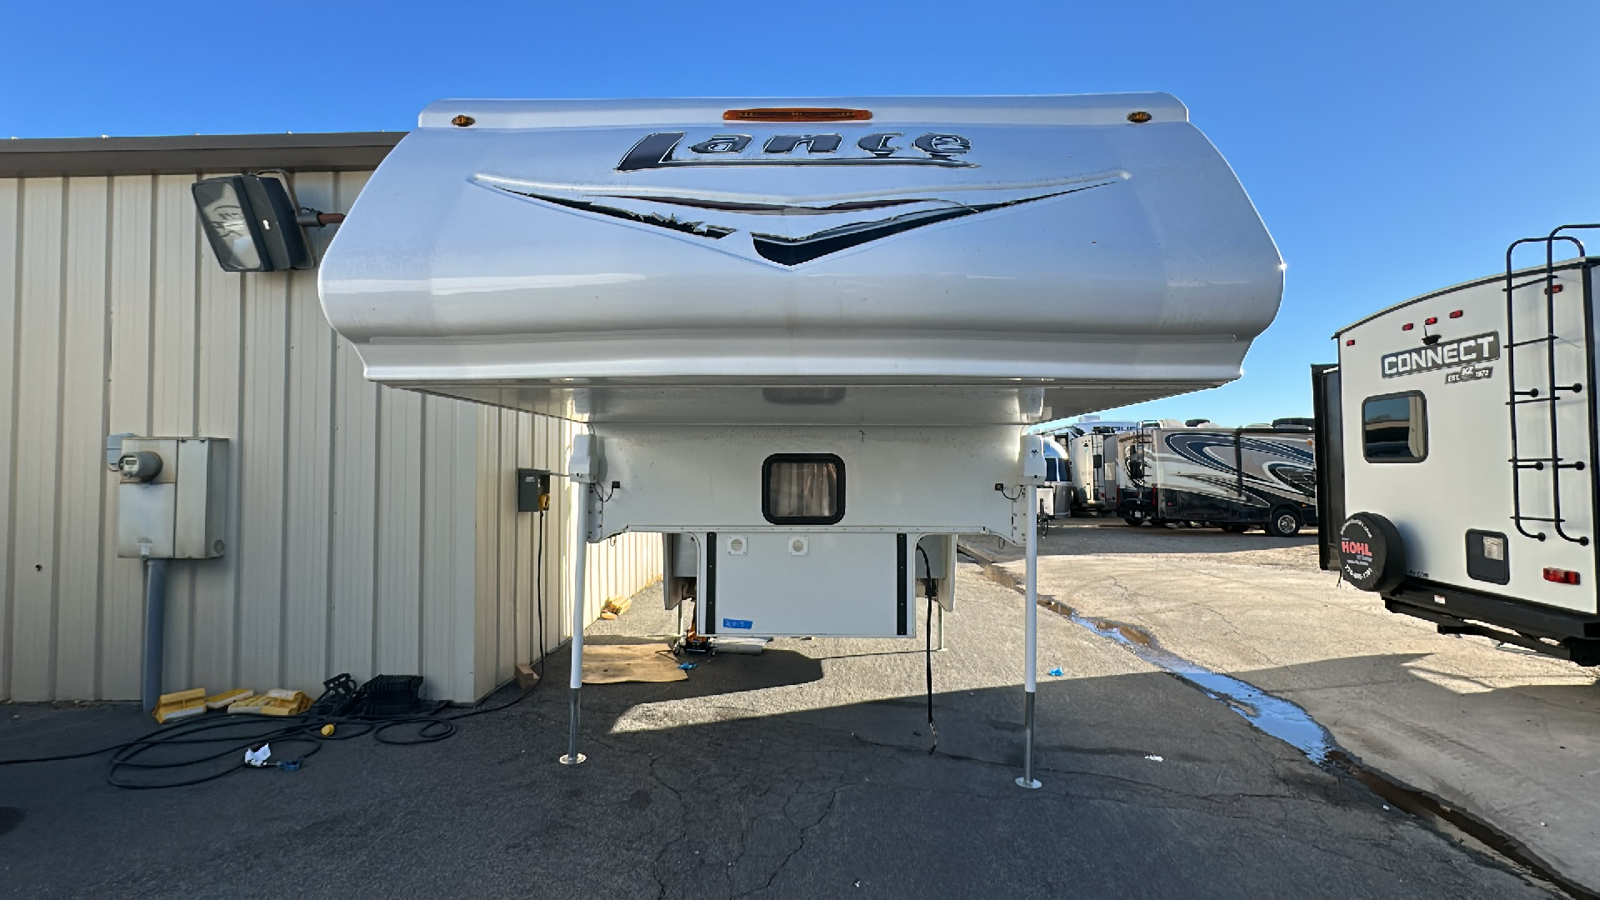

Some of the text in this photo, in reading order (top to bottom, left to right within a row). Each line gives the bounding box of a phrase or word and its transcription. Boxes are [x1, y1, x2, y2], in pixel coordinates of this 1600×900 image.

[613, 131, 980, 172] Lance
[1384, 335, 1494, 375] CONNECT
[1341, 541, 1373, 557] HOHL
